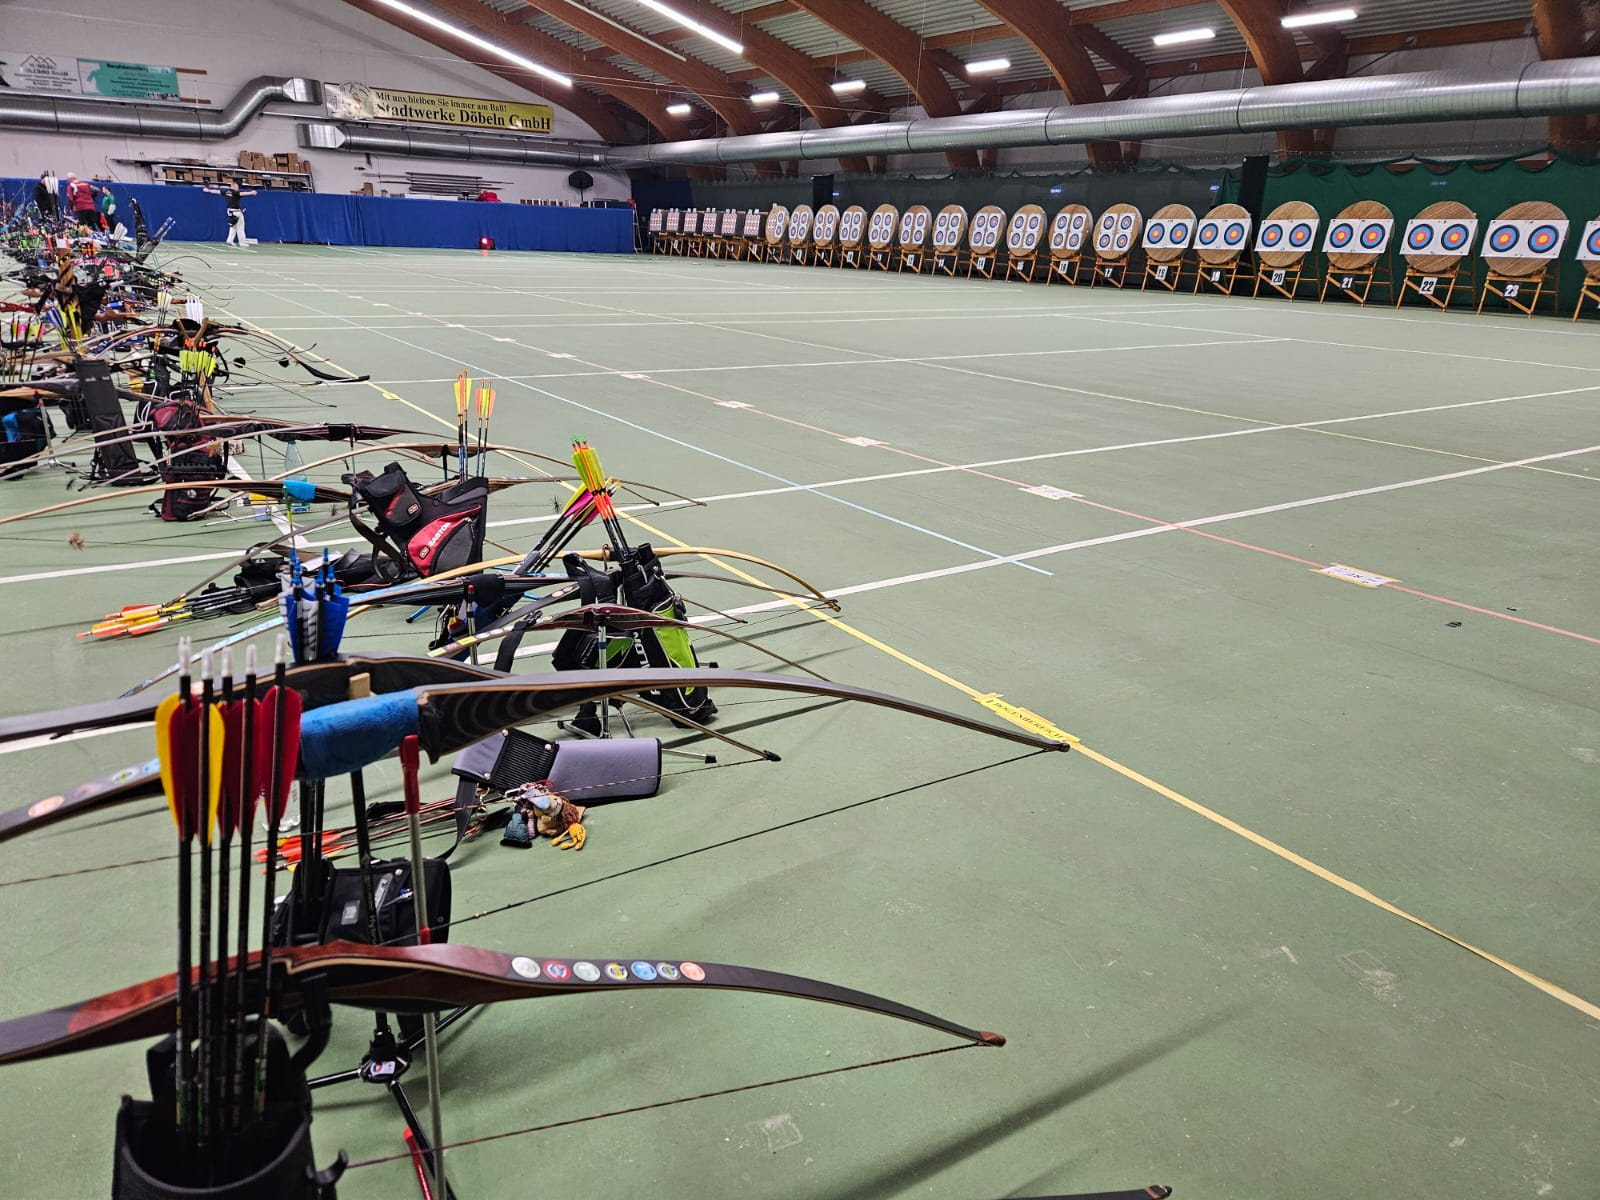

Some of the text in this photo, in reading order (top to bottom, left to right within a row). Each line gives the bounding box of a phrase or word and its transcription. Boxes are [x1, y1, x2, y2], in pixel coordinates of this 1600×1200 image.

[376, 91, 391, 101] Mit
[408, 96, 436, 106] bleiben
[438, 98, 449, 107] Sie
[450, 99, 475, 110] immer
[377, 102, 551, 130] Stadtwerke Döbeln GmbH
[1104, 268, 1113, 277] 17
[1273, 273, 1283, 282] 20
[1341, 277, 1353, 289] 21
[1421, 280, 1435, 292] 22
[1504, 285, 1519, 297] 23
